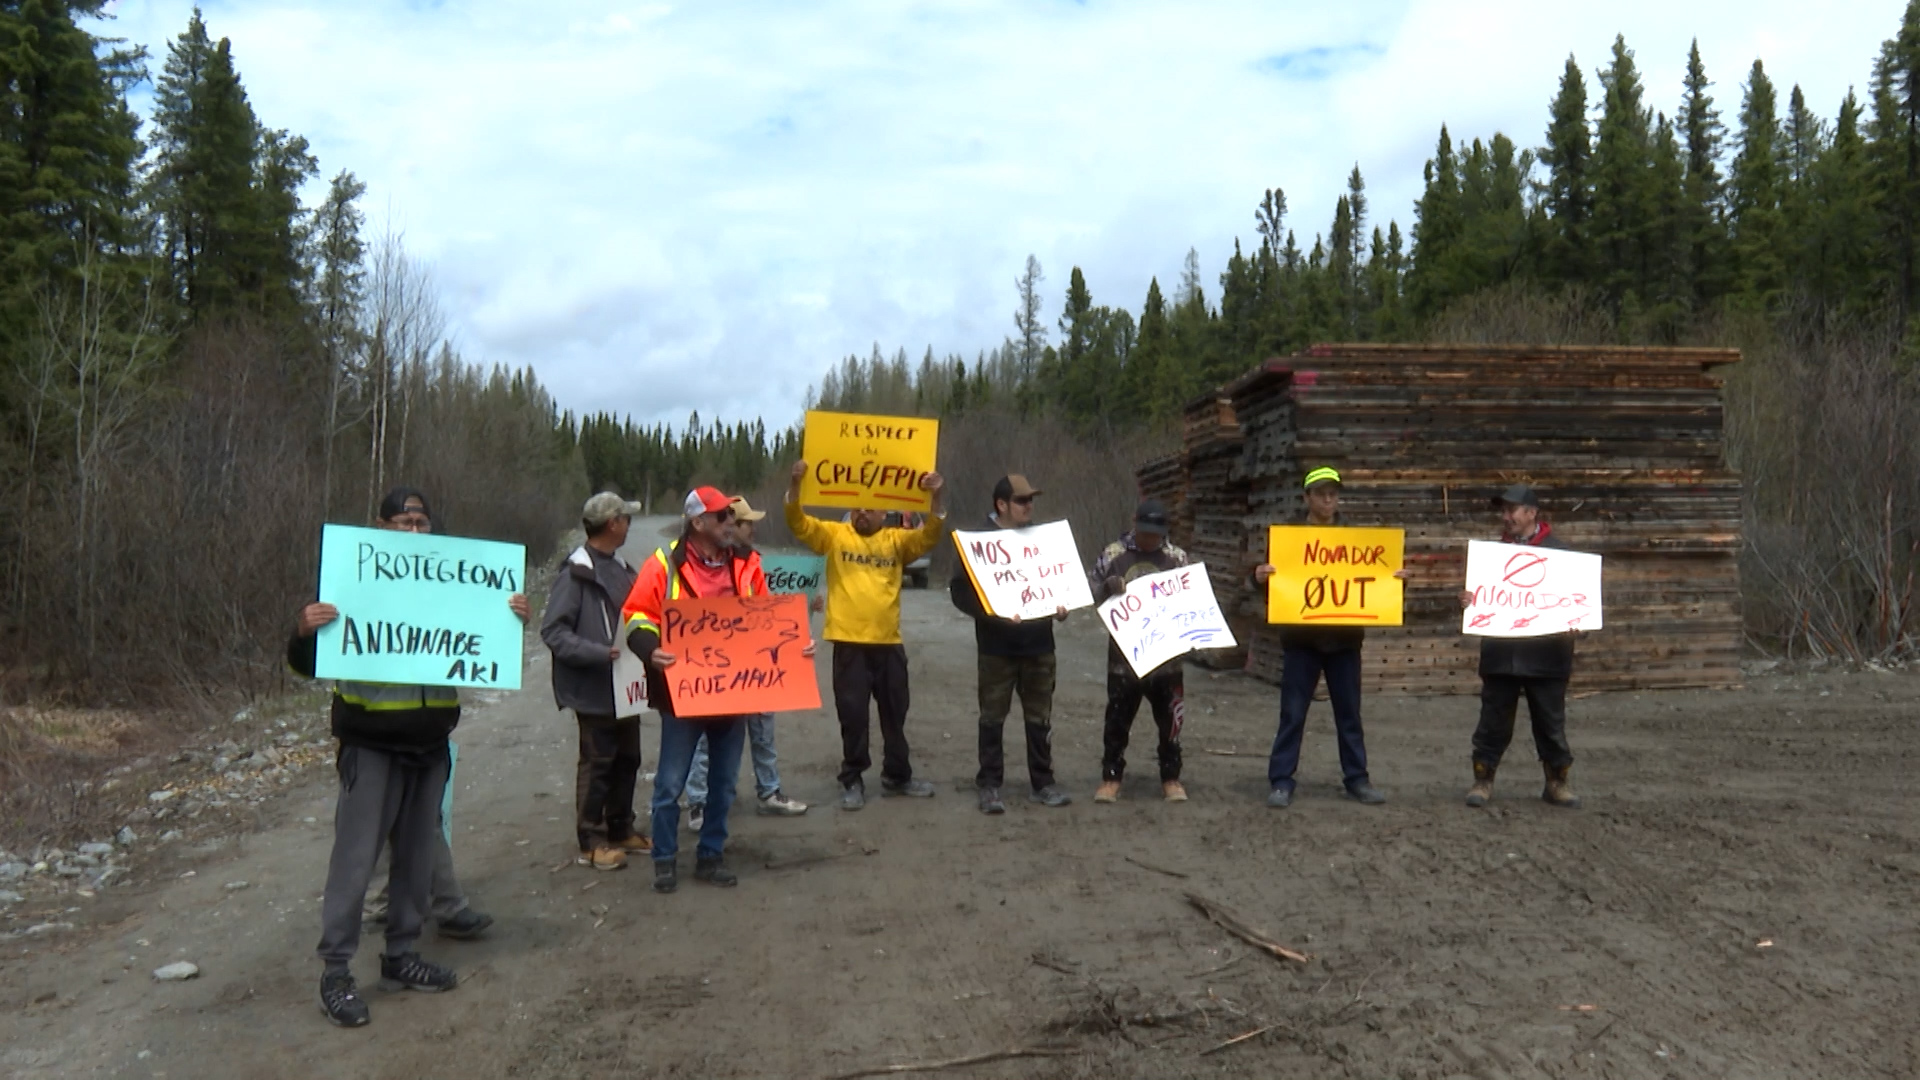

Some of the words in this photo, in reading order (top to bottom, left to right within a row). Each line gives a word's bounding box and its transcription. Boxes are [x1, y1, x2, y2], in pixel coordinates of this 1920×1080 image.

[840, 422, 918, 440] RESPECT
[970, 540, 1011, 565] MOS
[1304, 539, 1389, 567] NOVADOR
[1110, 594, 1142, 632] NO
[341, 614, 484, 657] ANISHNABE
[685, 647, 731, 668] LES
[446, 658, 498, 683] AKI
